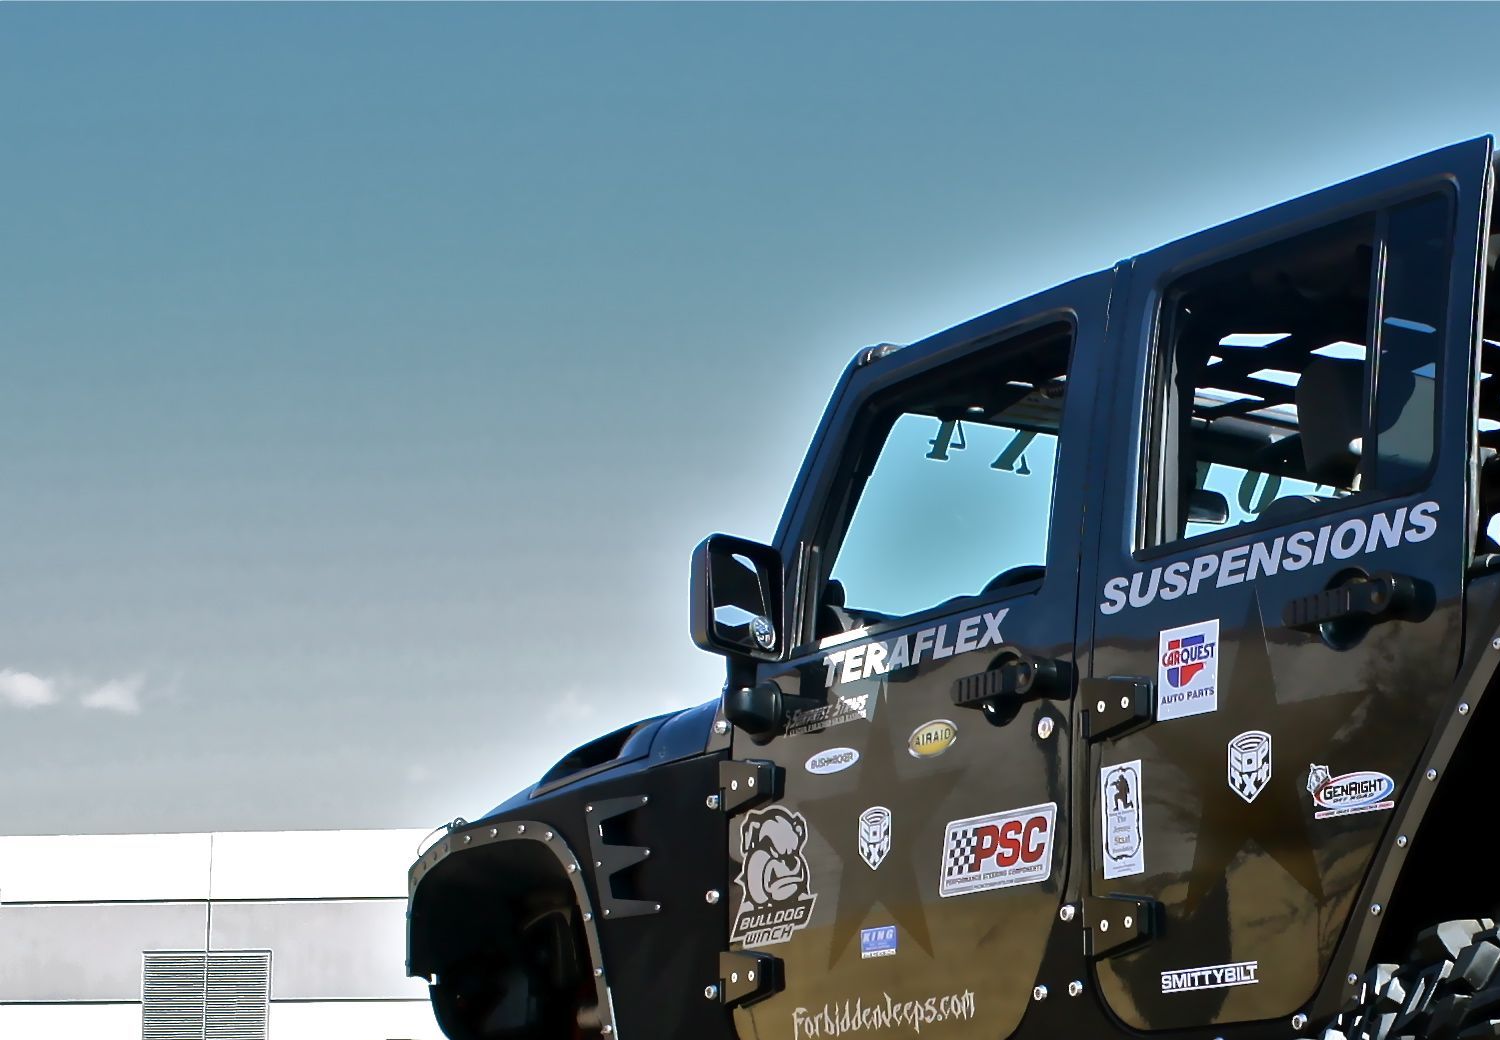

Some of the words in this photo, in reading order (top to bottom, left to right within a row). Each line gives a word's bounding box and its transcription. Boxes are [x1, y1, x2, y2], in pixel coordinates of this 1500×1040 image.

[823, 608, 1010, 688] TERAFLEX
[1100, 501, 1440, 615] SUSPENSIONS
[1162, 642, 1216, 667] CARQUEST
[1161, 693, 1184, 705] AUTO
[1187, 687, 1214, 701] PARTS
[915, 727, 951, 746] AIRAID
[968, 815, 1048, 873] PSC
[739, 905, 806, 931] BULLDOG
[744, 925, 793, 945] WINCH
[862, 928, 895, 944] KING
[1161, 964, 1258, 990] SMITTYBILT
